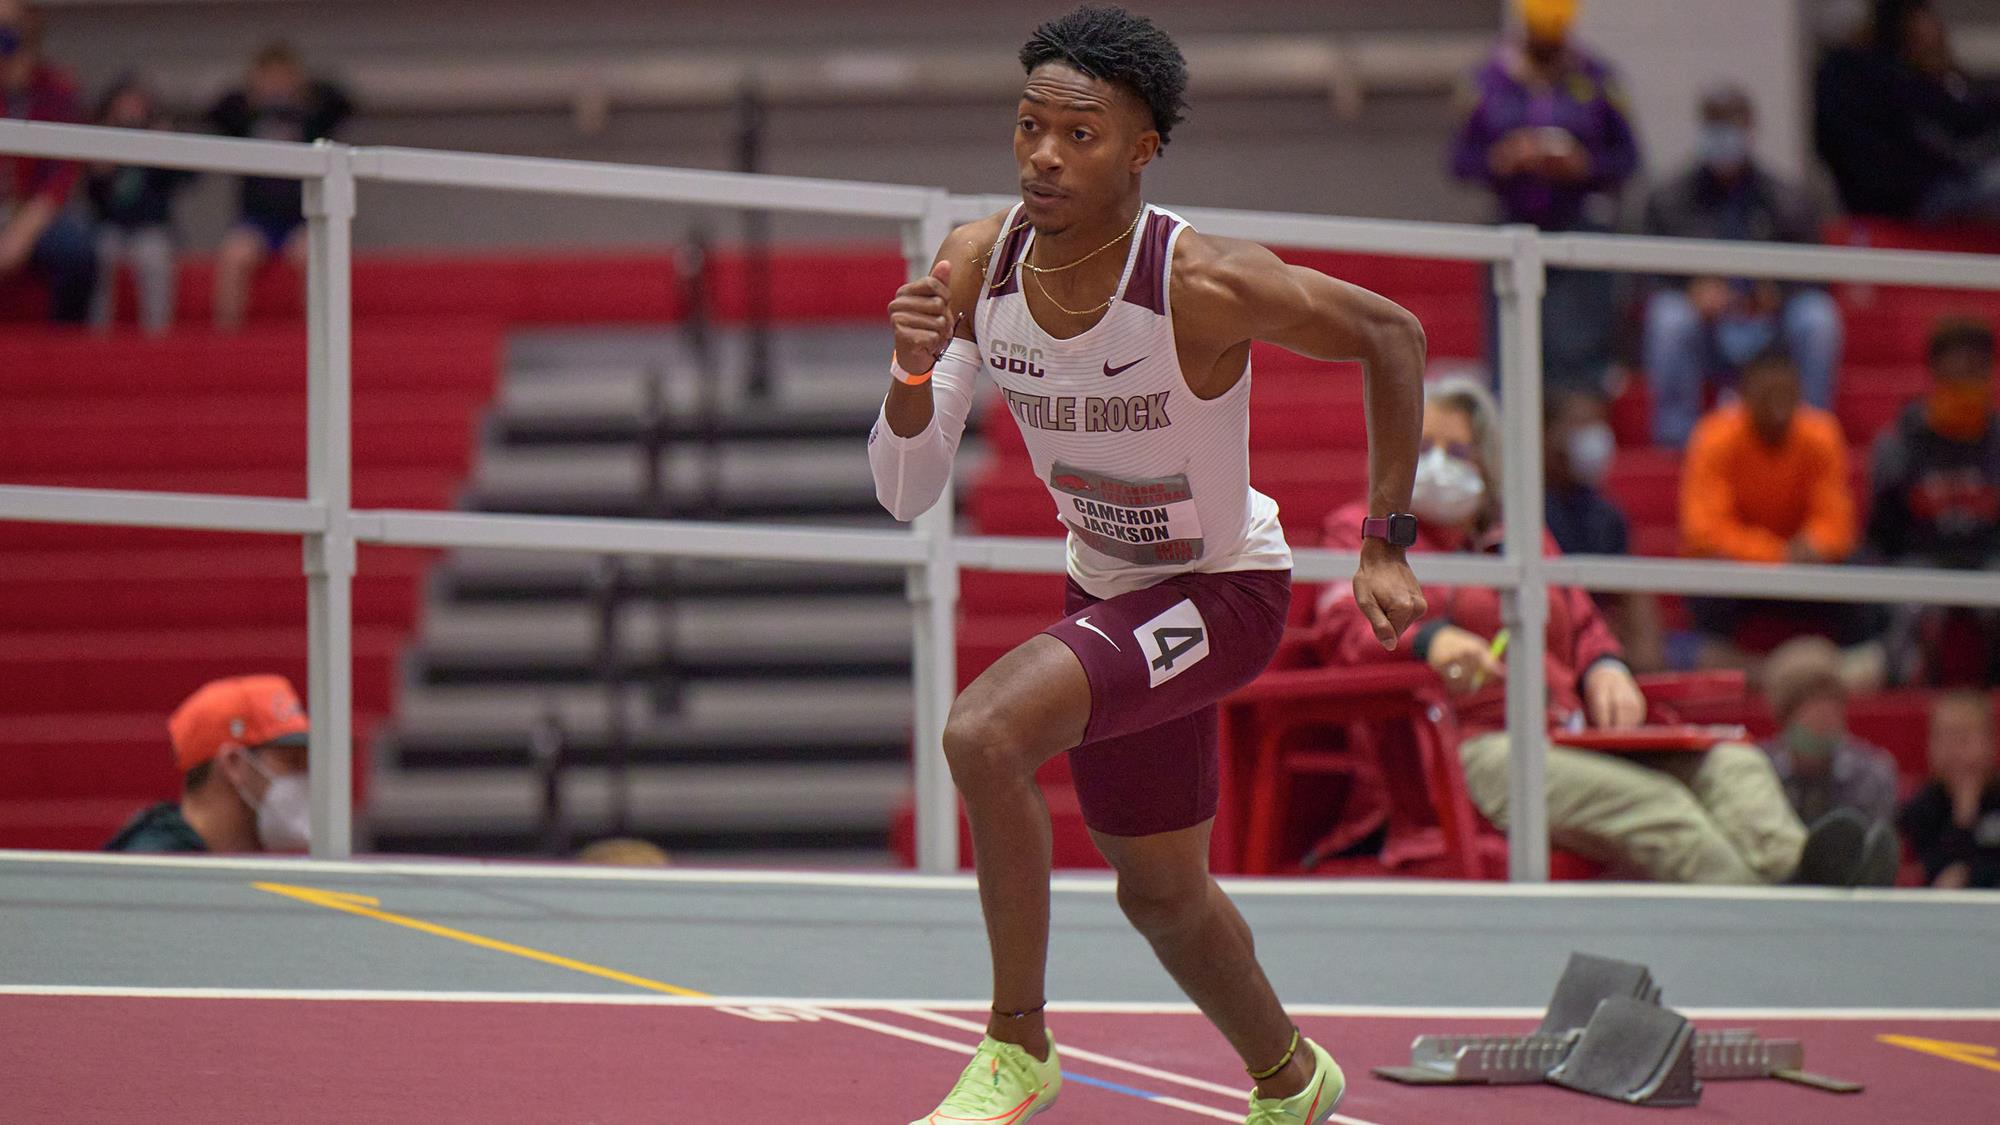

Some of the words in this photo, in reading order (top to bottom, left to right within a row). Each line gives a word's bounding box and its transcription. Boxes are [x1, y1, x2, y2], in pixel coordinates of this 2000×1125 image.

[989, 338, 1045, 378] SBC
[1085, 390, 1172, 432] ROCK
[1072, 497, 1169, 526] CAMERON
[1082, 515, 1170, 543] JACKSON
[1151, 626, 1204, 672] 4
